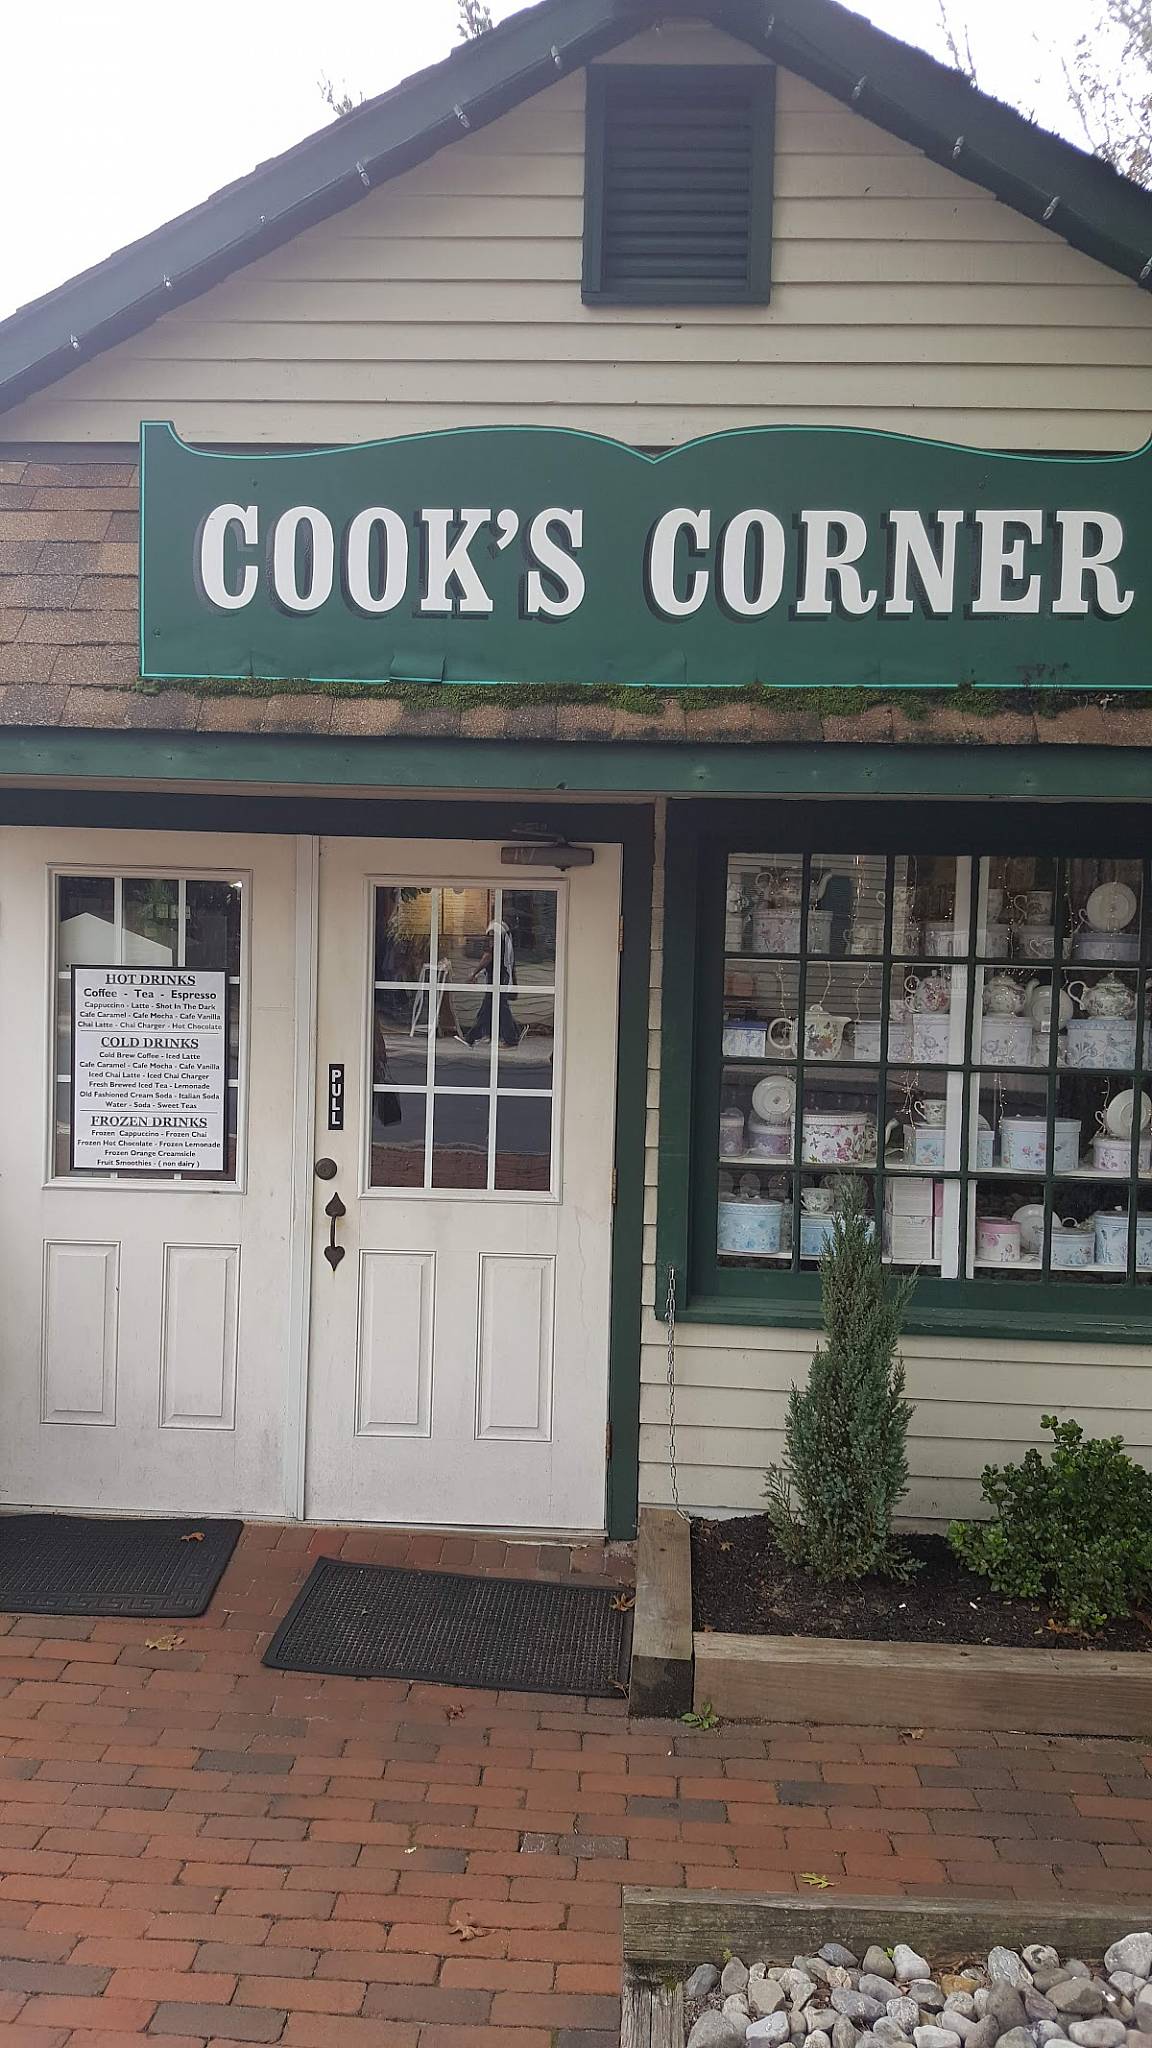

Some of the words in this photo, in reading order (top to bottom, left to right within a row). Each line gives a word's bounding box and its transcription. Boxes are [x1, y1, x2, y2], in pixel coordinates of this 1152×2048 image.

[200, 503, 586, 617] COOK'S
[649, 507, 1135, 616] CORNER
[105, 974, 137, 985] HOT
[140, 974, 196, 986] DRINKS
[84, 988, 117, 998] Coffee
[133, 989, 154, 998] Tea
[171, 990, 217, 1001] Espresso
[84, 1001, 125, 1010] Cappuccino
[155, 1002, 172, 1010] Shot
[101, 1036, 140, 1048] COLD
[142, 1037, 199, 1049] DRINKS
[180, 1073, 210, 1081] Charger
[174, 1082, 210, 1090] Lemonade
[331, 1069, 342, 1125] PULL
[91, 1115, 148, 1128] FROZEN
[151, 1117, 207, 1129] DRINKS
[119, 1130, 159, 1138] Cappuccino
[130, 1149, 156, 1158] Orange
[115, 1159, 152, 1167] Smoothies
